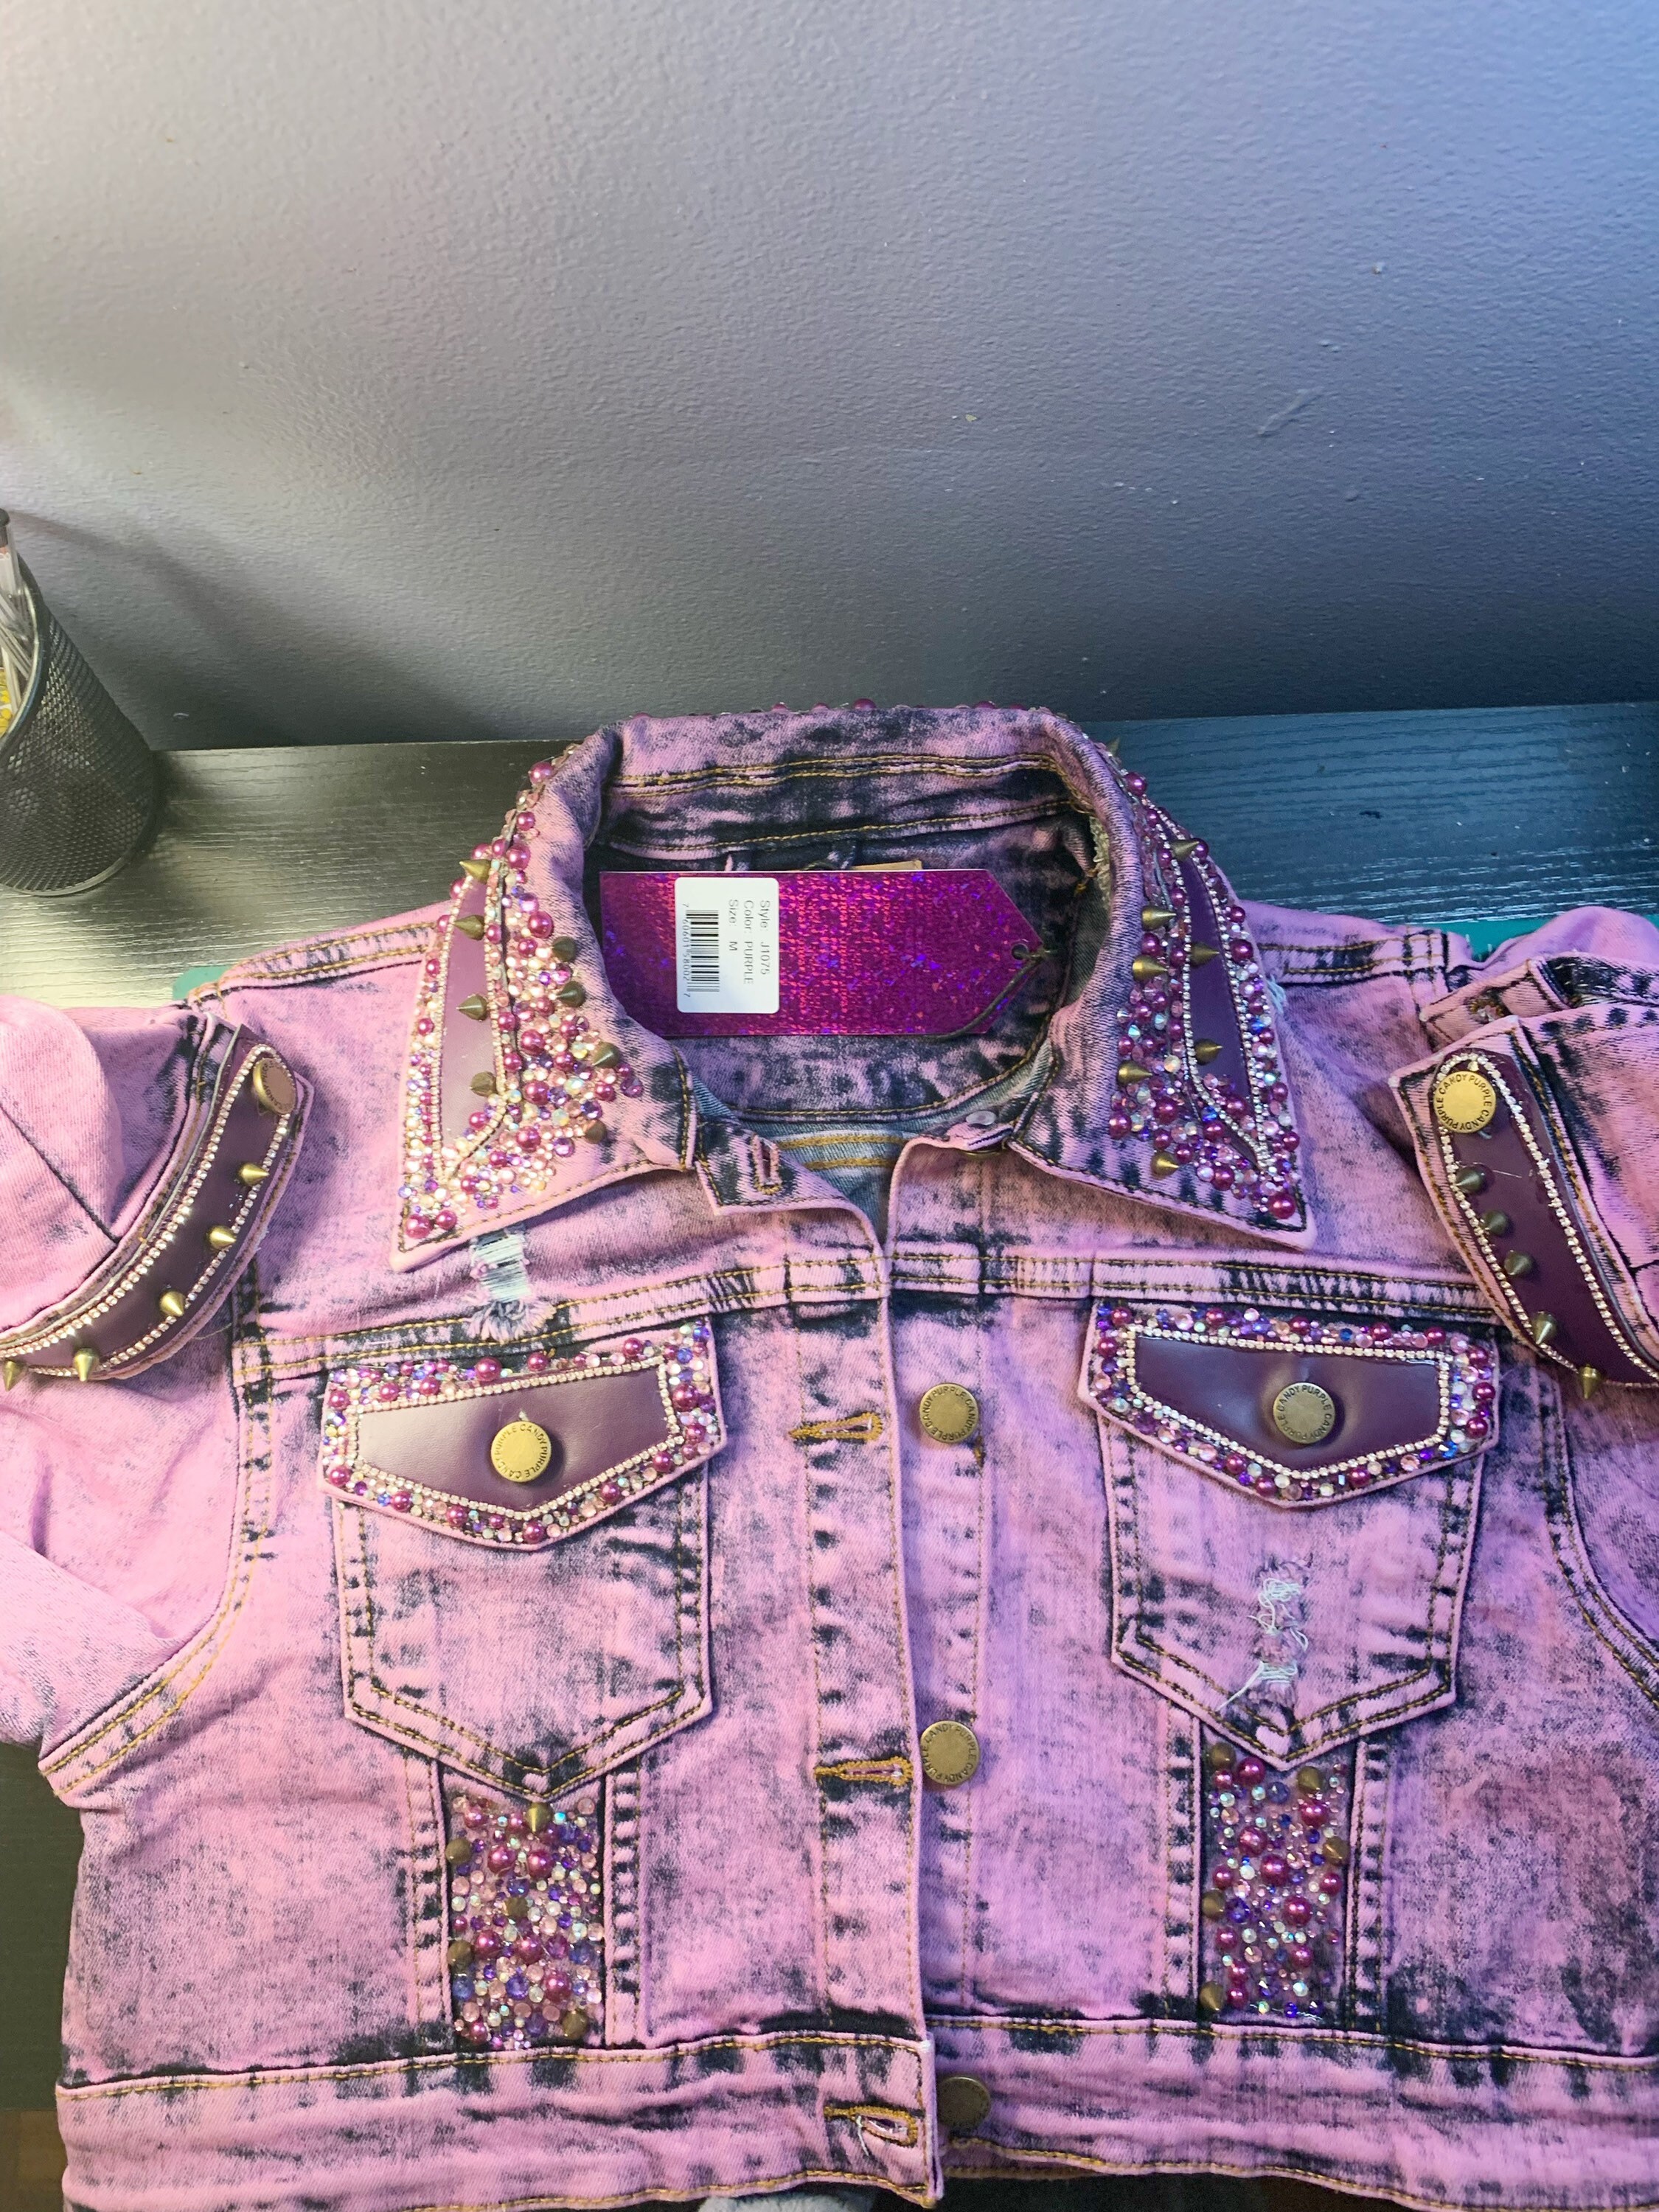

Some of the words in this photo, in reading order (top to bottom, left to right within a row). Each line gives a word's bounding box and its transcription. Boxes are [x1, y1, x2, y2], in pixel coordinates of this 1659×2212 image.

[728, 899, 739, 926] Size:
[743, 900, 754, 933] Color:
[758, 900, 771, 931] Style:
[729, 941, 737, 951] M
[760, 942, 770, 975] J1075
[743, 941, 754, 984] PURPLE
[1439, 1074, 1467, 1094] CANDY
[1469, 1075, 1492, 1107] PURPLE
[1436, 1097, 1458, 1129] PURPLE
[1459, 1110, 1489, 1130] CANDY
[922, 1396, 933, 1427] CANDY
[931, 1386, 967, 1399] PURPLE
[1276, 1385, 1299, 1412] CANDY
[1301, 1385, 1332, 1411] PURPLE
[964, 1399, 975, 1431] CANDY
[1311, 1413, 1332, 1439] CANDY
[519, 1424, 547, 1444] CANDY
[931, 1427, 966, 1441] PURPLE
[524, 1447, 548, 1478] PURPLE
[944, 1762, 973, 1782] CANDY
